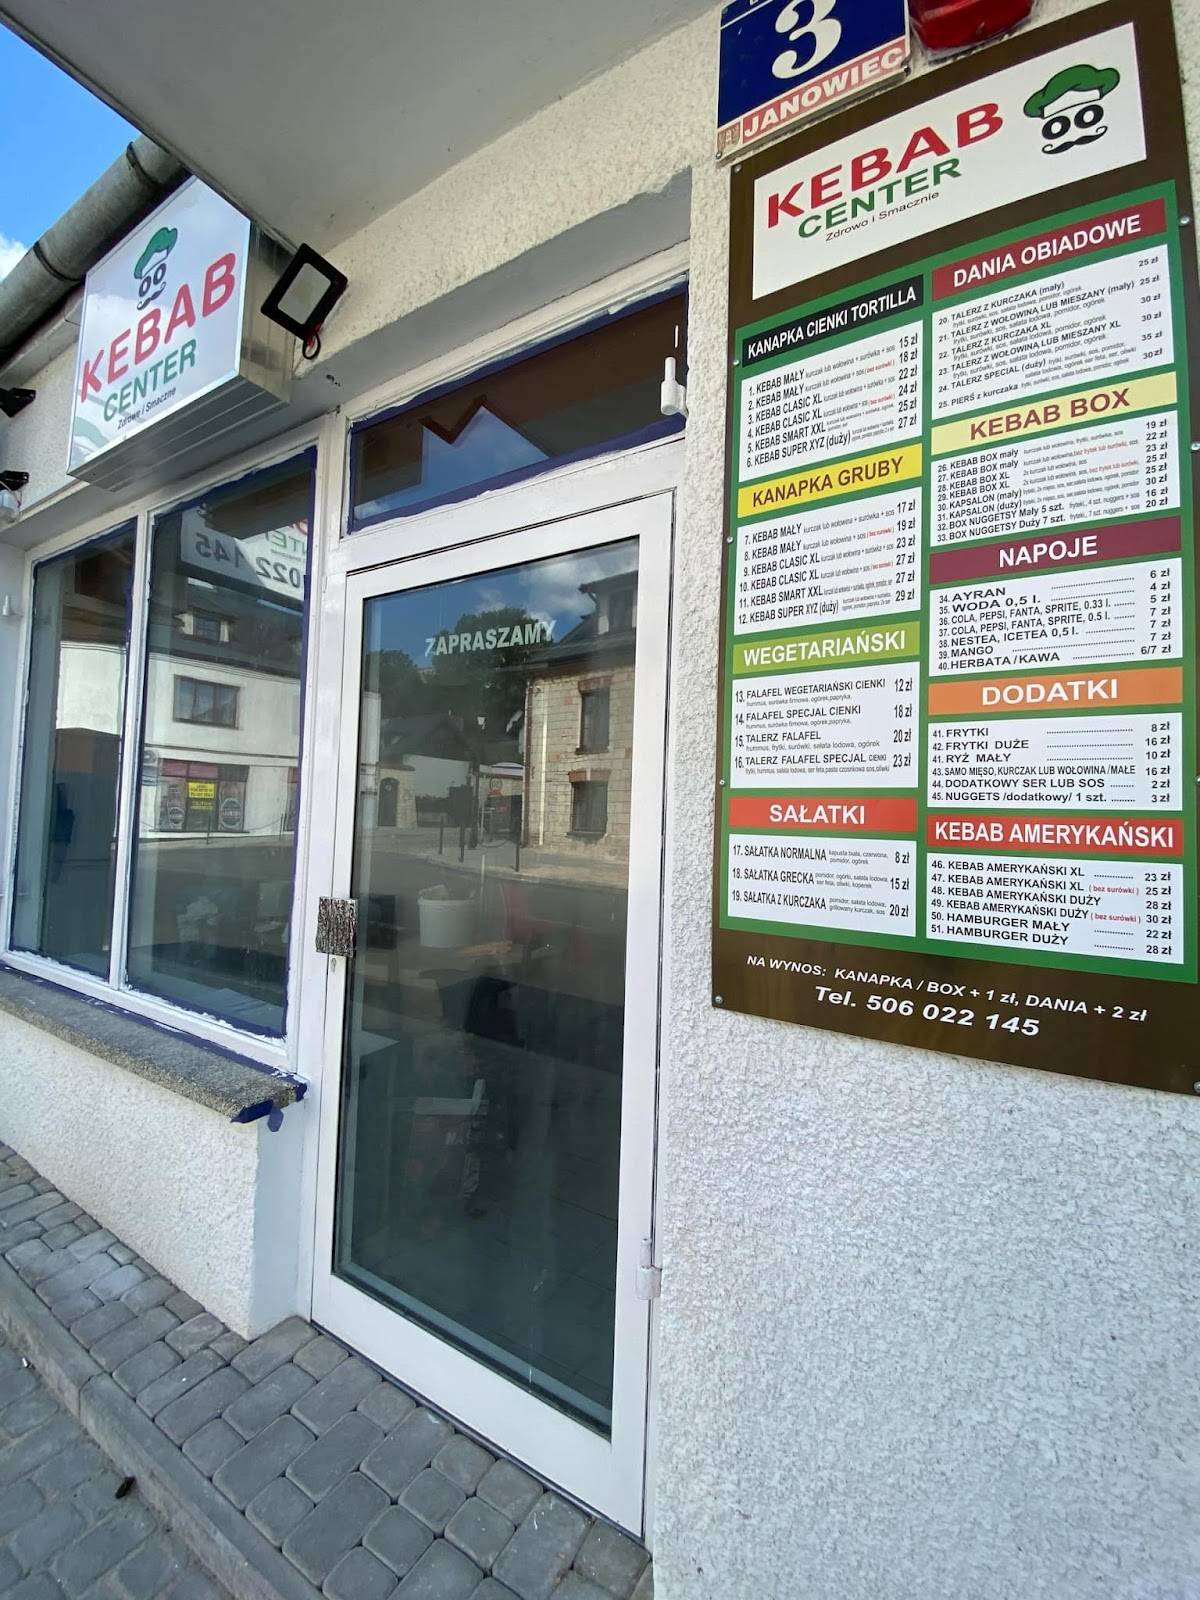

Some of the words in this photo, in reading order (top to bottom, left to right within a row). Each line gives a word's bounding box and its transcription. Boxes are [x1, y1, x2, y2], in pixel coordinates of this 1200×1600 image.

[772, 0, 842, 79] 3
[744, 48, 903, 138] JANOWIEC
[768, 103, 1003, 228] KEBAB
[798, 158, 962, 238] CENTER
[826, 218, 868, 242] Zdrowo
[879, 191, 940, 220] Smacznie
[953, 253, 1016, 287] DANIA
[1021, 214, 1141, 264] OBIADOWE
[939, 315, 948, 325] 20.
[951, 306, 981, 320] TALERZ
[990, 289, 1037, 308] KURCZAKA
[1138, 258, 1149, 267] 25
[1151, 255, 1158, 264] zł
[81, 252, 236, 403] KEBAB
[748, 326, 804, 360] KANAPKA
[807, 312, 848, 337] CIENKI
[851, 286, 916, 322] TORTILLA
[104, 339, 196, 422] CENTER
[749, 384, 754, 396] 1.
[756, 376, 781, 394] KEBAB
[783, 368, 804, 385] MAŁY
[899, 335, 908, 349] 15
[910, 332, 917, 345] zł
[938, 383, 948, 392] 24.
[951, 375, 981, 388] TALERZ
[1141, 333, 1152, 341] 35
[1155, 330, 1162, 338] zł
[970, 404, 1060, 440] KEBAB
[1070, 388, 1130, 418] BOX
[746, 456, 752, 467] 6.
[754, 449, 779, 465] KEBAB
[781, 441, 807, 458] SUPER
[809, 436, 824, 450] XYZ
[826, 429, 850, 449] (duży)
[898, 416, 907, 428] 27
[909, 413, 916, 425] zł
[753, 474, 833, 507] KANAPKA
[838, 456, 903, 486] GRUBY
[937, 533, 947, 542] 33.
[949, 529, 966, 539] BOX
[969, 521, 1016, 536] NUGGETSY
[1019, 517, 1040, 529] Duży
[1043, 516, 1047, 524] 7
[1050, 514, 1065, 523] szt.
[1145, 499, 1156, 507] 20
[1159, 496, 1167, 505] zł
[999, 535, 1098, 568] NAPOJE
[739, 597, 748, 608] 11.
[750, 592, 776, 606] KEBAB
[778, 587, 805, 602] SMART
[807, 584, 822, 597] XXL
[895, 572, 905, 583] 27
[907, 570, 914, 581] zł
[939, 595, 950, 603] 34.
[952, 587, 1005, 601] AYRAN
[1150, 570, 1156, 578] 6
[1161, 568, 1169, 577] zł
[939, 617, 949, 625] 36.
[951, 613, 977, 624] COLA,
[980, 610, 1006, 621] PEPSI,
[1009, 606, 1042, 618] FANTA,
[1045, 601, 1080, 614] SPRITE,
[1084, 599, 1102, 609] 0.33
[1150, 595, 1156, 603] 5
[1161, 592, 1170, 601] zł
[425, 620, 556, 656] ZAPRASZAMY
[744, 630, 906, 666] WEGETARIAŃSKI
[938, 650, 949, 658] 39.
[951, 646, 993, 657] MANGO
[1161, 631, 1170, 639] zł
[735, 690, 744, 702] 13.
[746, 687, 781, 698] FALAFEL
[784, 679, 852, 695] WEGETARIAŃSKI
[855, 678, 885, 689] CIENKI
[894, 678, 903, 692] 12
[905, 677, 912, 691] zł
[982, 679, 1118, 706] DODATKI
[734, 735, 744, 747] 15.
[746, 733, 777, 742] TALERZ
[782, 731, 821, 741] FALAFEL
[893, 729, 902, 742] 20
[904, 728, 911, 741] zł
[946, 741, 987, 750] FRYTKI
[995, 738, 1028, 748] DUŻE
[1160, 735, 1169, 744] zł
[769, 804, 865, 824] SAŁATKI
[946, 792, 999, 800] NUGGETS
[1002, 792, 1071, 803] /dodatkowy/
[1076, 792, 1080, 801] 1
[1085, 793, 1106, 801] szt.
[1151, 794, 1156, 802] 3
[1160, 793, 1169, 802] zł
[935, 821, 1004, 842] KEBAB
[1009, 820, 1174, 848] AMERYKAŃSKI
[931, 860, 945, 868] 46.
[948, 860, 983, 870] KEBAB
[986, 860, 1066, 875] AMERYKAŃSKI
[1070, 867, 1084, 876] XL
[1144, 873, 1156, 881] 23
[1161, 871, 1171, 881] zł
[732, 889, 741, 901] 19.
[743, 891, 775, 904] SAŁATKA
[777, 894, 781, 904] Z
[783, 894, 826, 909] KURCZAKA
[889, 904, 899, 916] 20
[901, 905, 908, 917] zł
[931, 924, 944, 933] 51.
[946, 925, 1027, 941] HAMBURGER
[1032, 931, 1068, 945] DUŻY
[1146, 944, 1157, 954] 28
[1161, 944, 1171, 954] zł
[746, 954, 766, 967] NA
[768, 958, 826, 978] WYNOS:
[834, 968, 912, 990] KANAPKA
[927, 980, 965, 997] BOX
[970, 988, 981, 998] +
[986, 988, 994, 1001] 1
[1000, 991, 1018, 1007] zł,
[1025, 994, 1088, 1014] DANIA
[1093, 1005, 1105, 1016] +
[1112, 1006, 1123, 1018] 2
[1129, 1008, 1147, 1022] zł
[815, 986, 857, 1007] Tel.
[867, 995, 914, 1016] 506
[923, 1004, 973, 1026] 022
[986, 1013, 1040, 1036] 145
